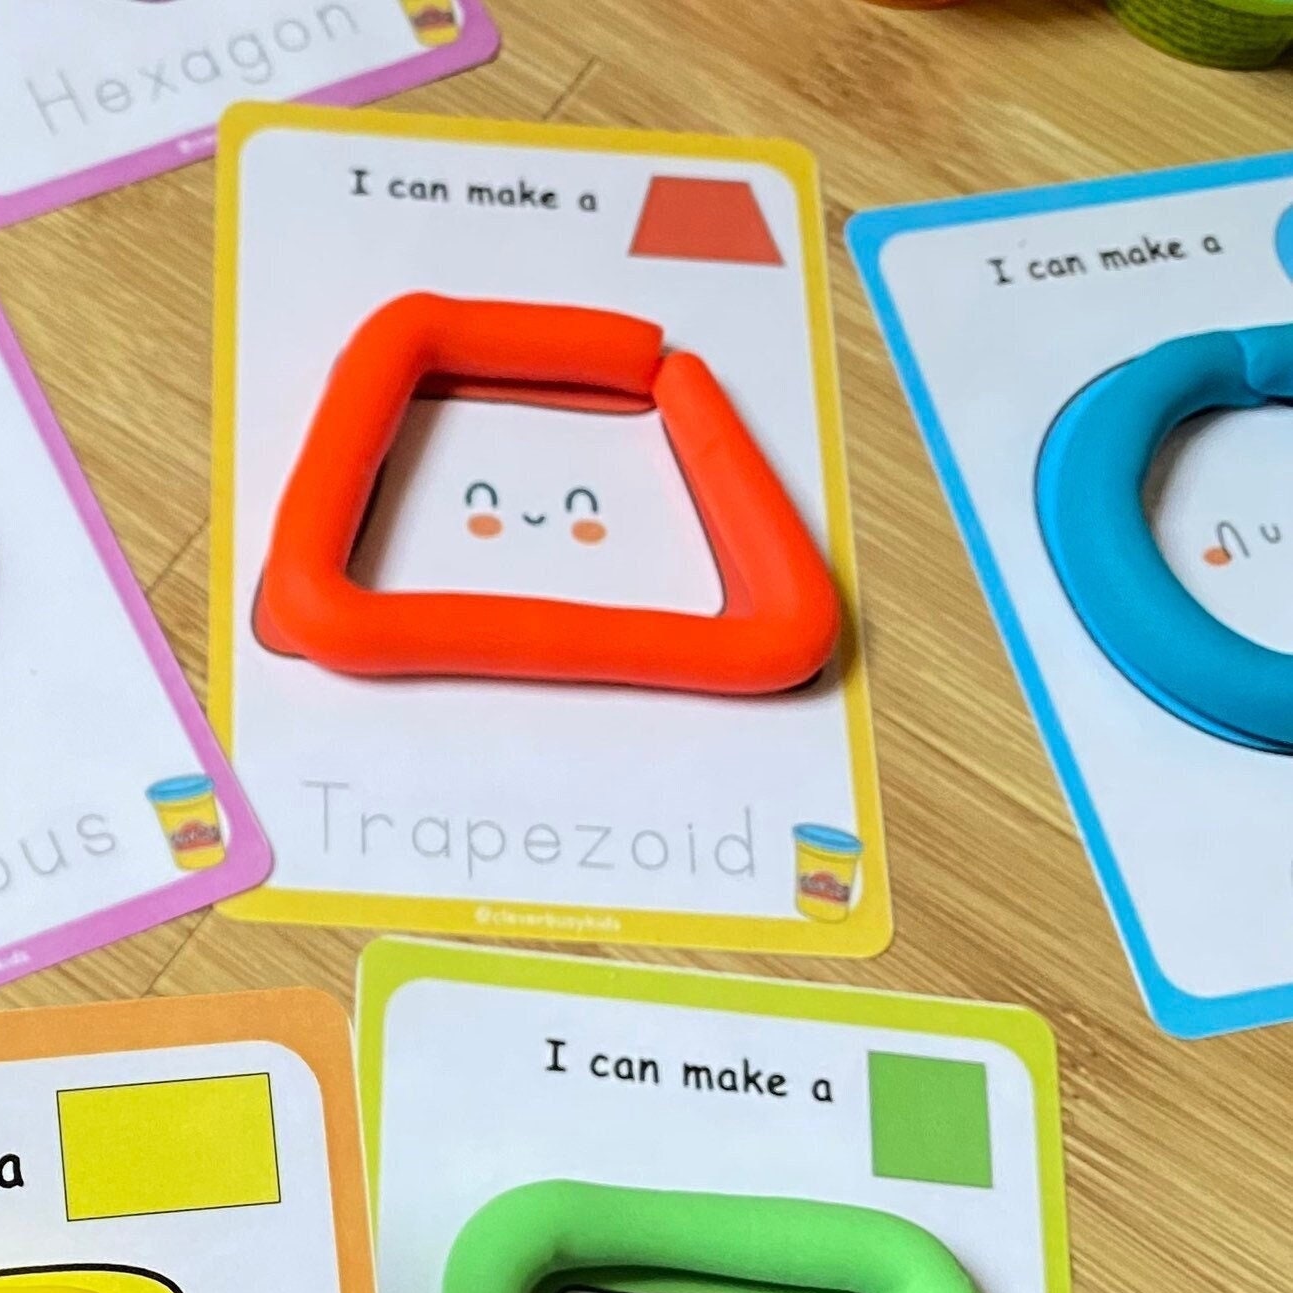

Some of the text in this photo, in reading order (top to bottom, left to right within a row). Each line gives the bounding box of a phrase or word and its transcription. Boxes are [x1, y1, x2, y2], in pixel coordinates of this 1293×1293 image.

[25, 3, 359, 135] Hexagon
[352, 168, 599, 213] I can make a
[988, 234, 1224, 286] I can make a
[301, 780, 757, 879] Trapezoid
[546, 1038, 835, 1103] I can make a
